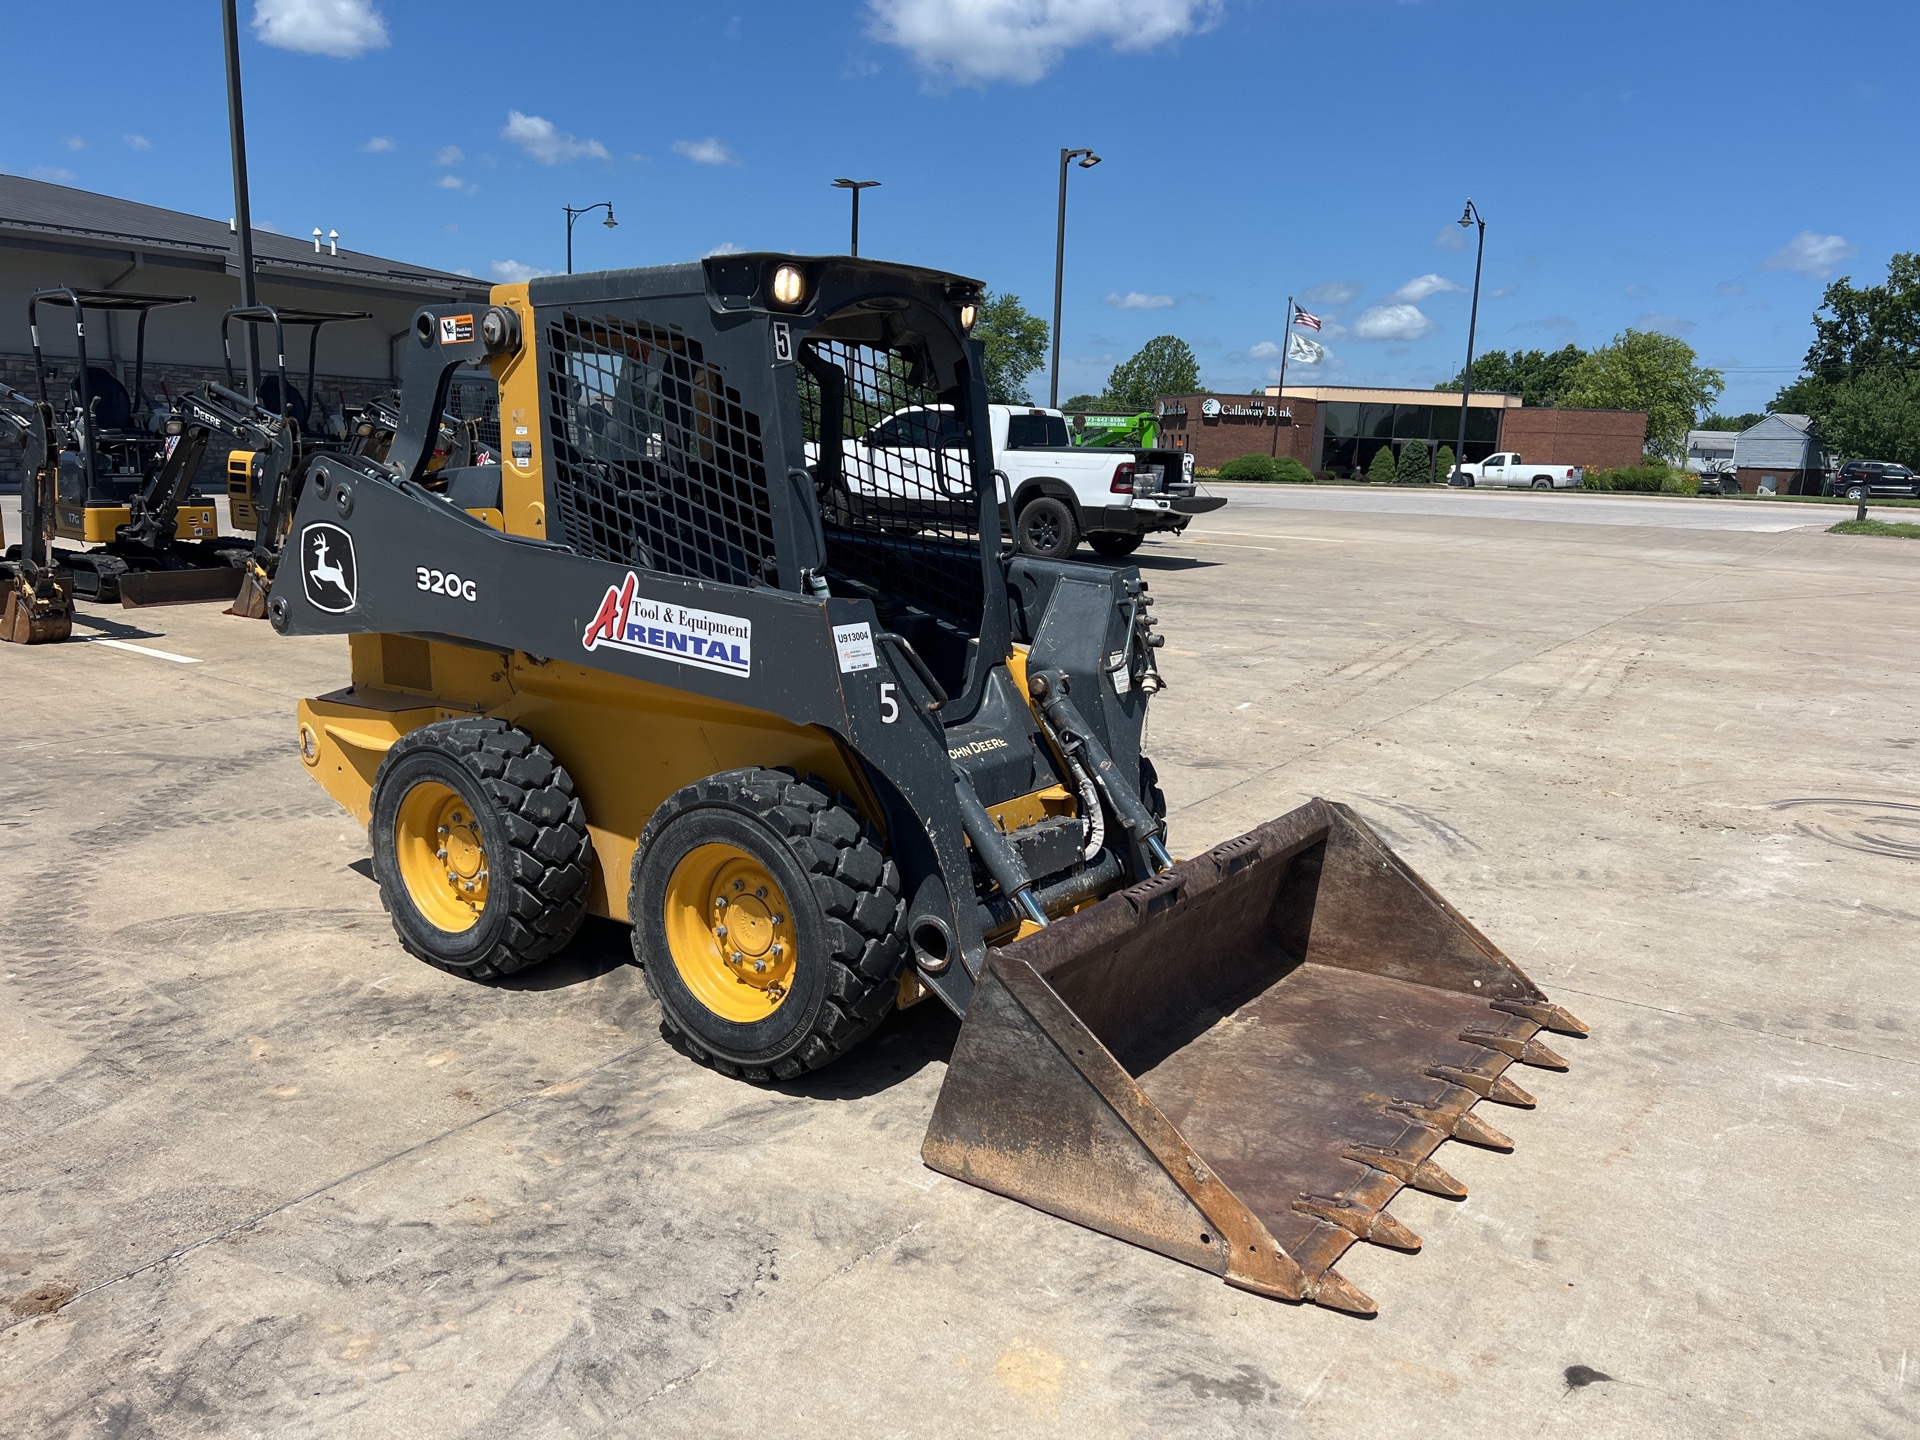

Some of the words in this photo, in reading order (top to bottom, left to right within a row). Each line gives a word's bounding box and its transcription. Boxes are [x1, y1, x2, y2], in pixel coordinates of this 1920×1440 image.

[776, 324, 788, 357] 5
[193, 406, 221, 429] DEERE
[380, 411, 398, 429] DEE
[1221, 404, 1264, 419] Callaway
[1267, 406, 1292, 418] Bank
[68, 513, 80, 524] 17G
[203, 514, 209, 523] 4
[416, 566, 477, 602] 320G
[585, 574, 635, 647] A1
[632, 600, 659, 621] Tool
[663, 608, 674, 624] &
[679, 609, 749, 639] Equipment
[626, 622, 748, 666] RENTAL
[837, 631, 869, 644] U913004
[881, 683, 899, 724] 5
[948, 745, 973, 760] OHN
[969, 738, 1008, 754] DEERE
